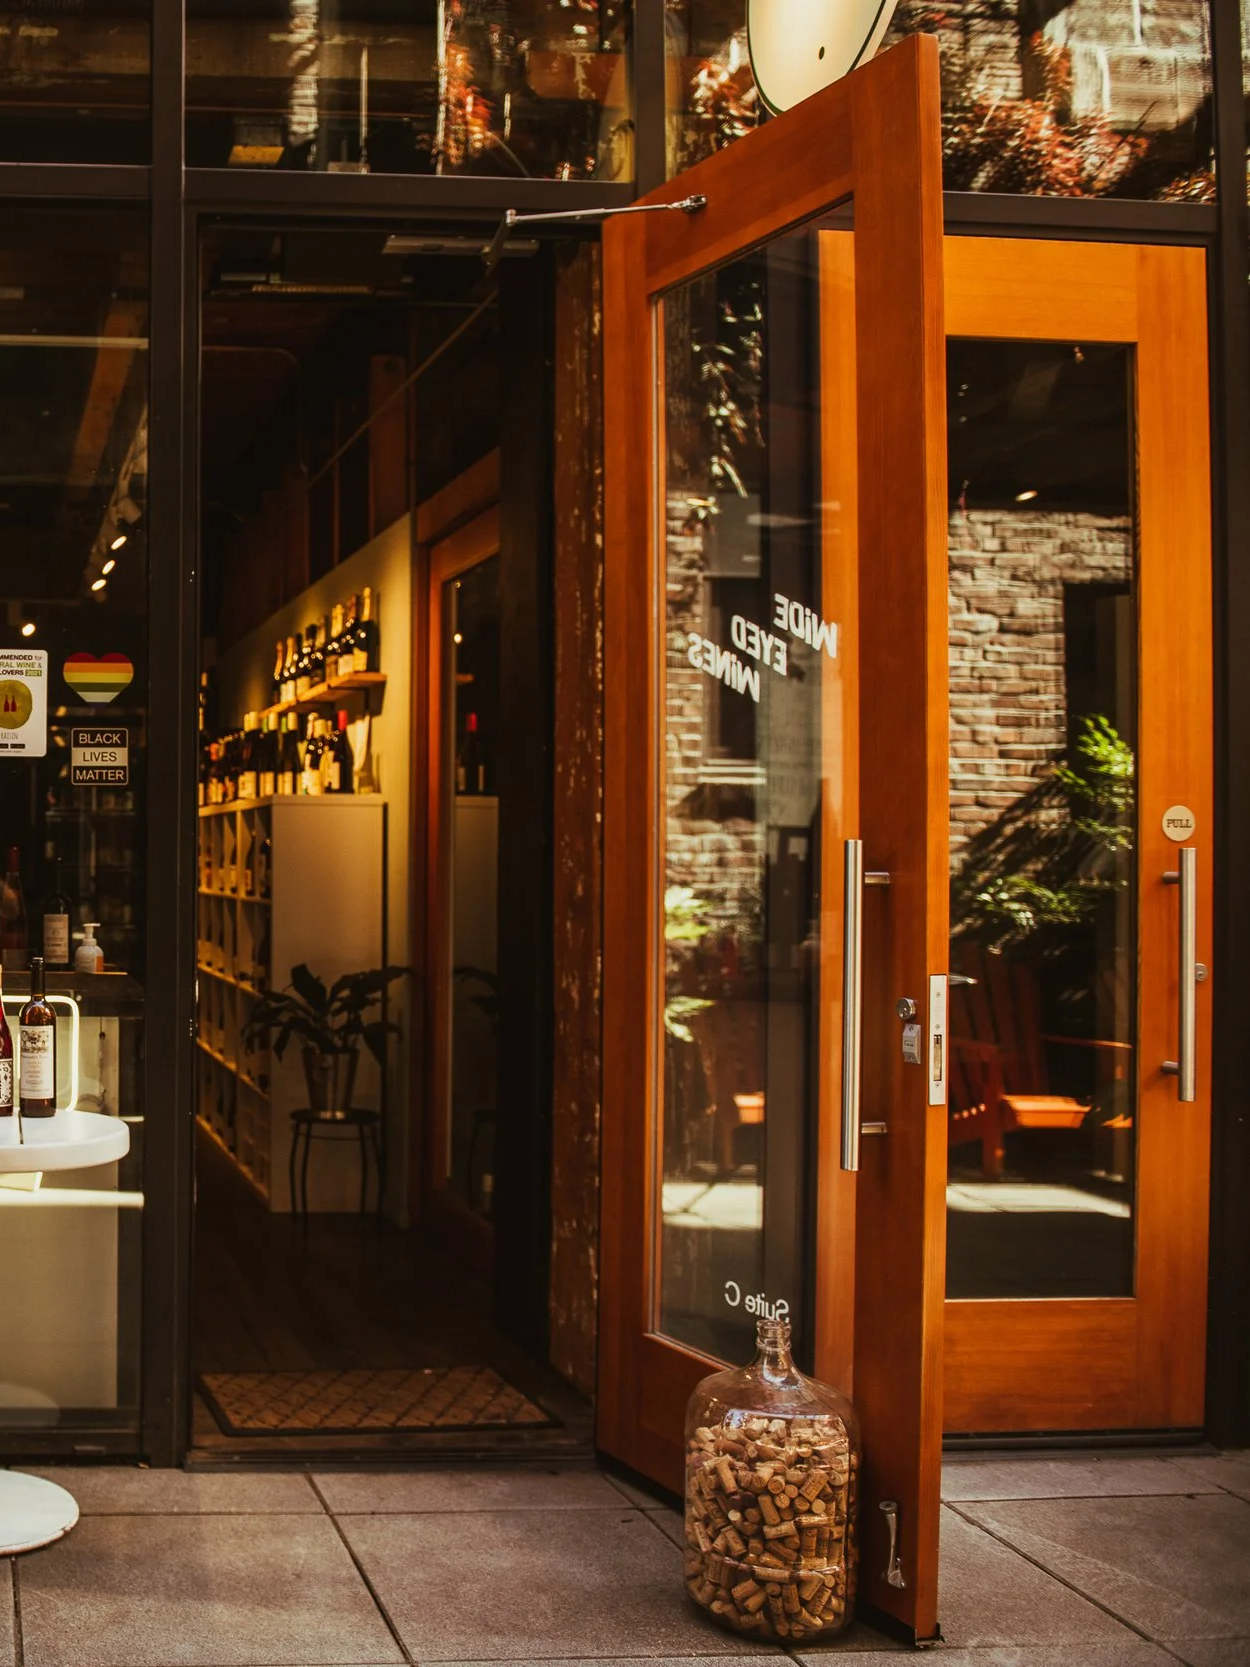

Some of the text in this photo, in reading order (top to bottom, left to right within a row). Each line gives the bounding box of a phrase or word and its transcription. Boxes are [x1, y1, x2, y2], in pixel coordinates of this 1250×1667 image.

[79, 733, 121, 744] BLACK
[83, 752, 117, 762] LIVES
[76, 770, 124, 780] MATTER
[1166, 819, 1192, 828] PULL
